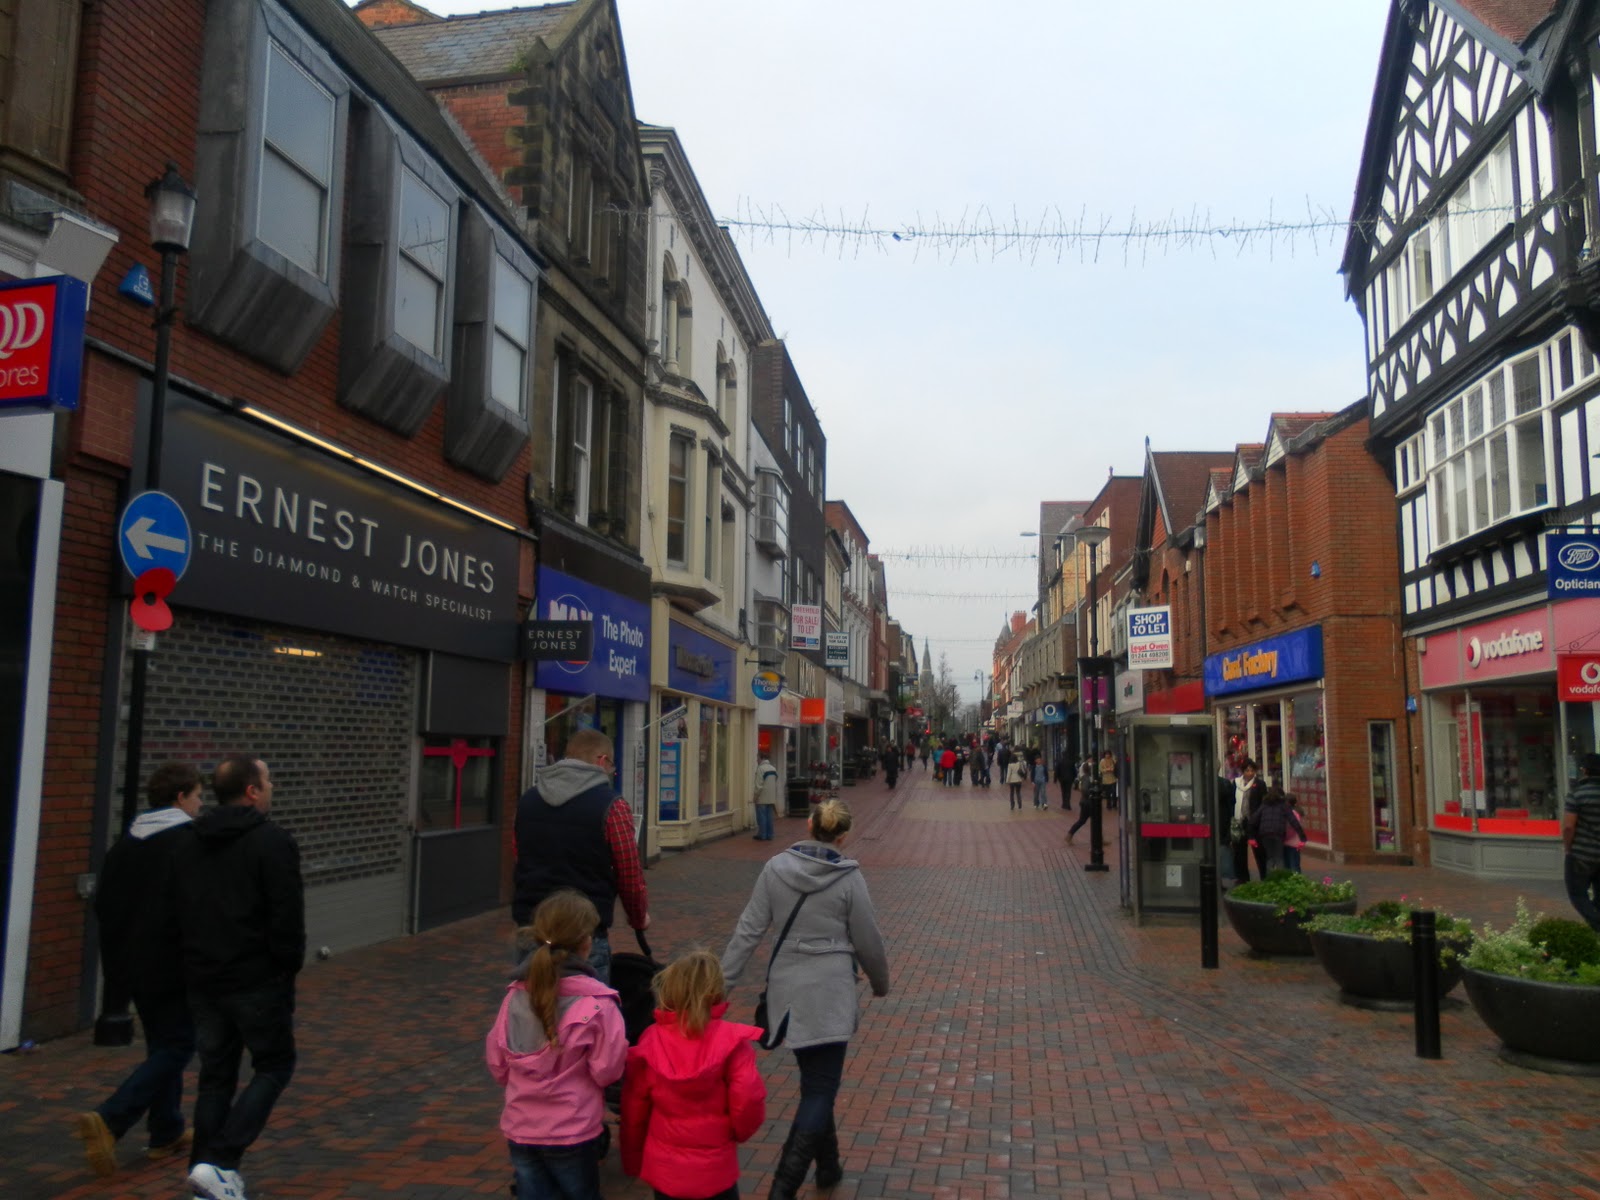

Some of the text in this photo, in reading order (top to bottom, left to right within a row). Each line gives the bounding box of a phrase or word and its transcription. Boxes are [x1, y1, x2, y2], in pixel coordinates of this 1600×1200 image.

[200, 462, 494, 593] ERNEST JONES
[1564, 549, 1594, 565] Boots
[198, 533, 493, 621] THE DIAMOND & WATCH SPECIALIST
[1555, 579, 1600, 591] Optician
[793, 615, 804, 624] FOR
[1134, 613, 1163, 625] SHOP
[528, 630, 583, 639] ERNEST
[602, 614, 644, 648] The Photo
[798, 625, 815, 634] TO LET
[1132, 623, 1166, 635] TO LET
[532, 641, 578, 650] JONES
[1482, 629, 1545, 660] vodafone
[609, 649, 637, 679] Expert
[1222, 648, 1278, 681] Card Factory
